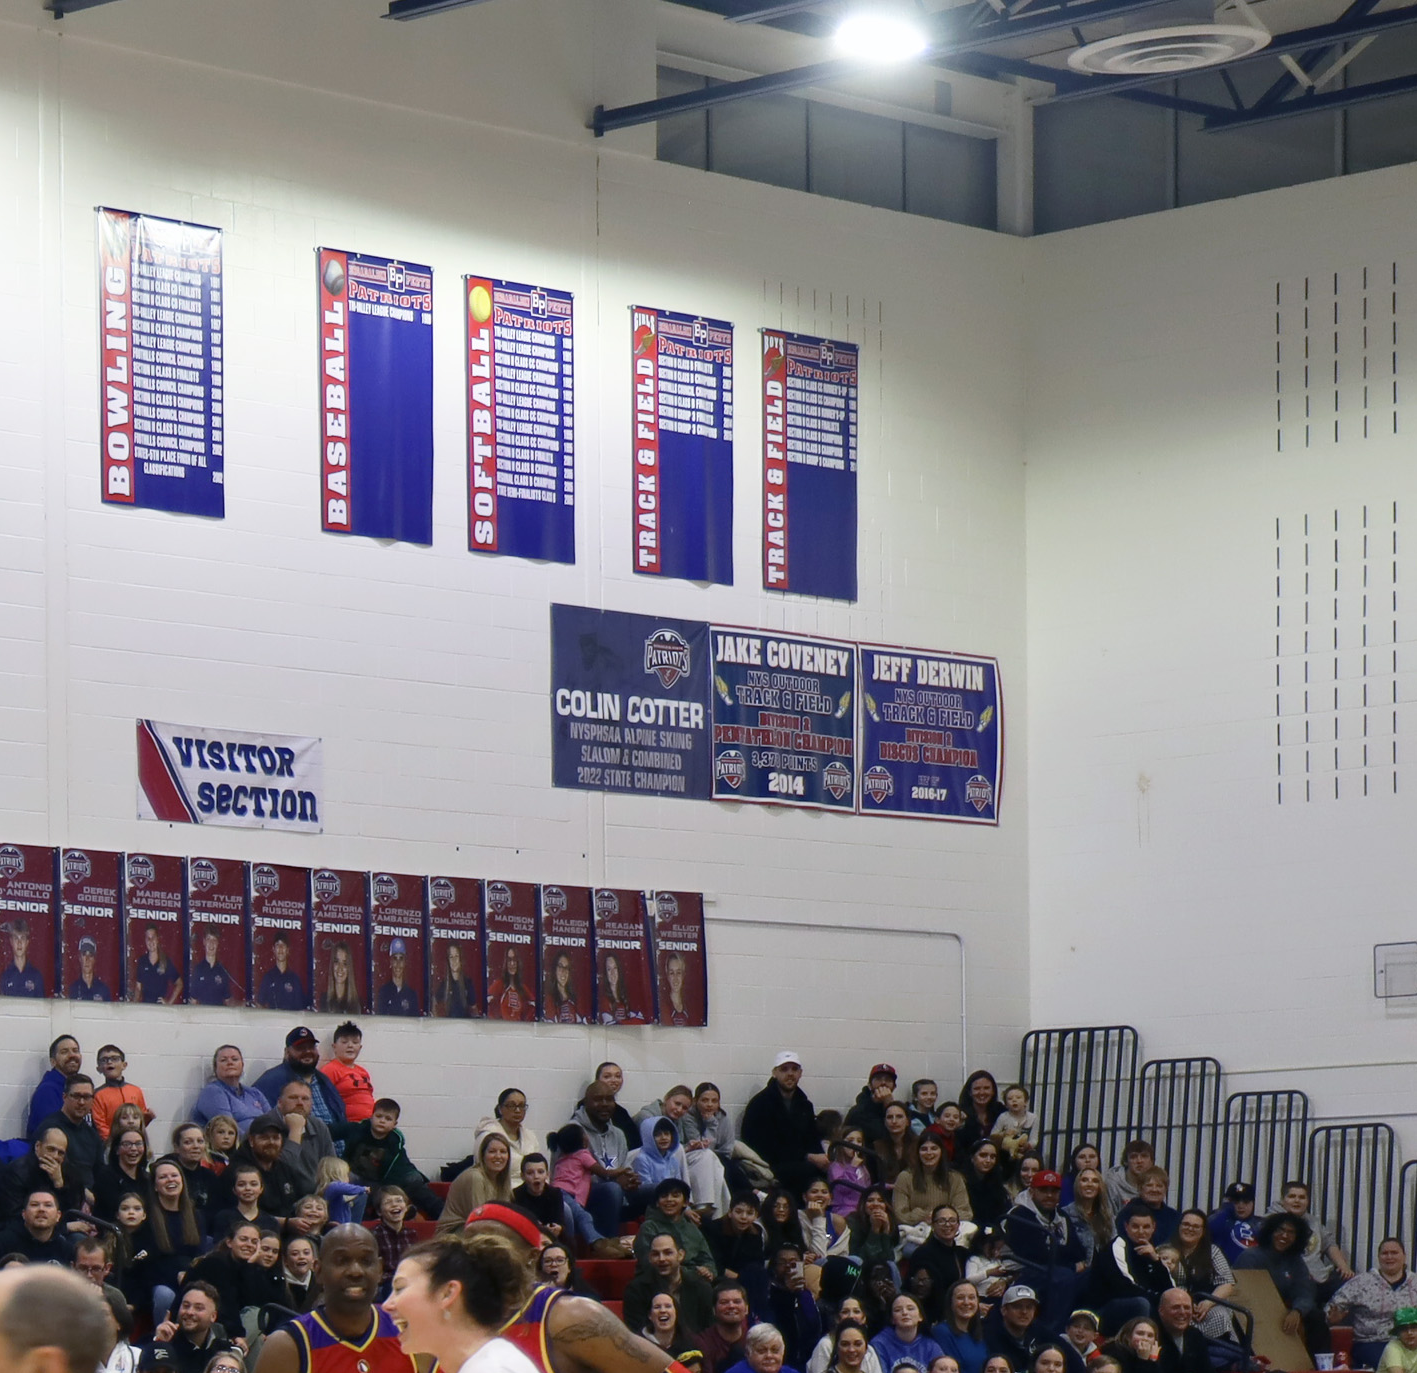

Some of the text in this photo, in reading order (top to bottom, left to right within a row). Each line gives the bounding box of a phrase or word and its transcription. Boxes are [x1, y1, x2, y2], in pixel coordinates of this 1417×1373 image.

[634, 312, 655, 334] GIRLS
[764, 335, 784, 356] BOYS
[105, 266, 130, 496] BOWLING
[324, 301, 348, 527] BASEBALL
[471, 328, 494, 545] SOFTBALL
[636, 358, 657, 567] TRACK & FIELD
[766, 380, 785, 583] TRACK & FIELD
[647, 645, 689, 673] PATRIOTS
[716, 635, 849, 677] JAKE COVENEY
[747, 670, 820, 694] NYS OUTDOOR
[873, 654, 984, 691] JEFF DERWIN
[556, 688, 704, 729] COLIN COTTER
[736, 685, 832, 715] TRACK & FIELD
[895, 688, 962, 710] NYS OUTDOOR
[882, 703, 975, 730] TRACK & FIELD
[624, 728, 657, 746] ALPINE
[794, 731, 853, 757] CHAMPION
[172, 736, 295, 778] VISITOR
[581, 745, 682, 770] SLALOM & COMBINED
[577, 767, 686, 792] 2022 STATE CHAMPION
[768, 772, 805, 796] 2014
[672, 924, 700, 933] ELLIOT
[658, 940, 698, 952] SENIOR
